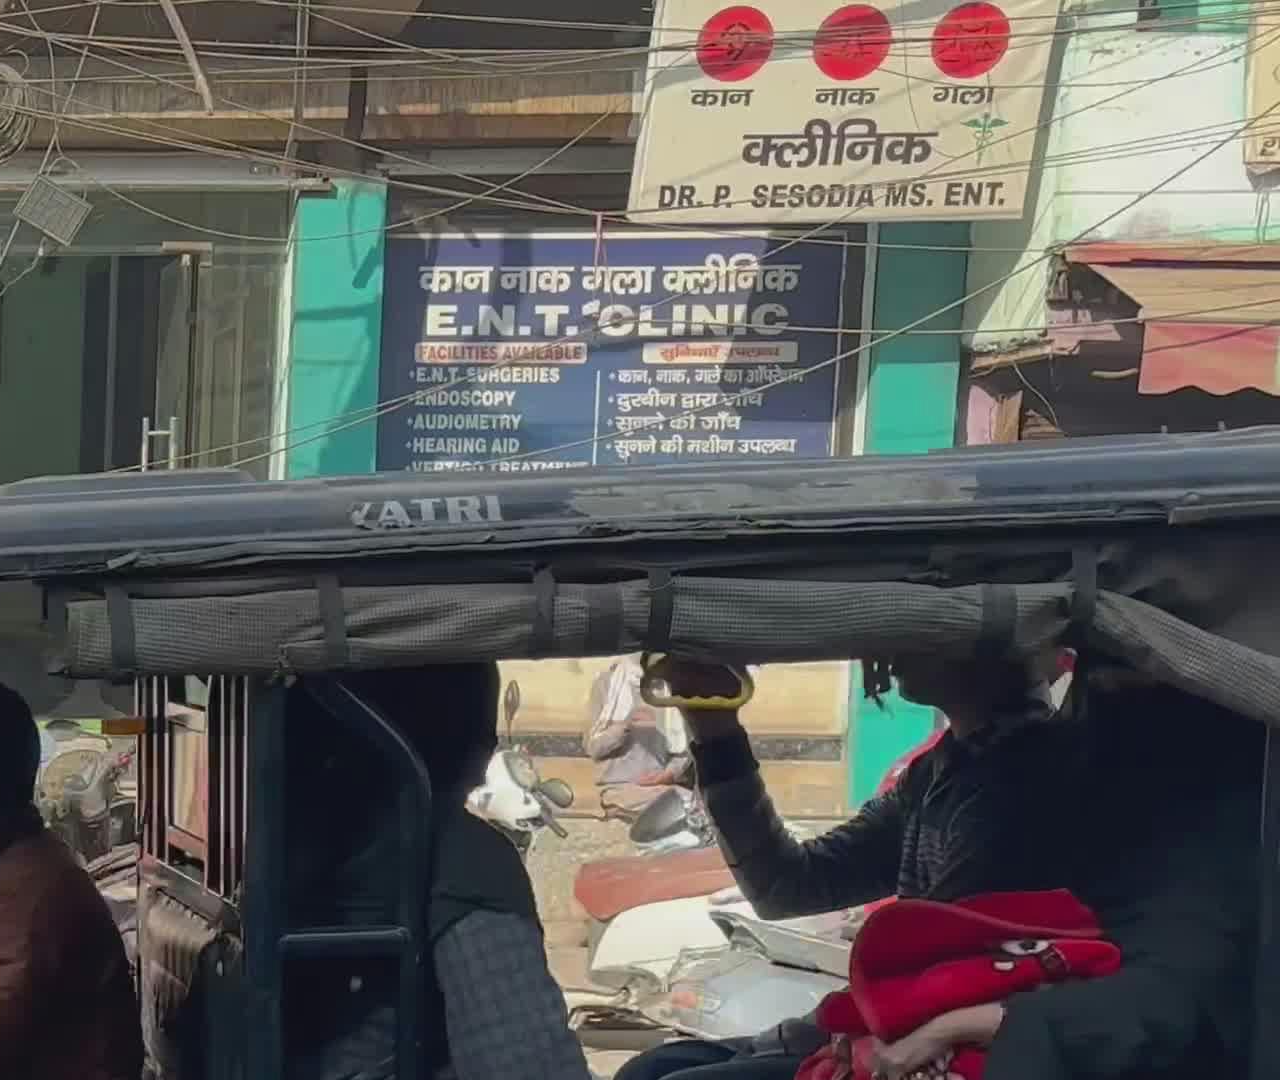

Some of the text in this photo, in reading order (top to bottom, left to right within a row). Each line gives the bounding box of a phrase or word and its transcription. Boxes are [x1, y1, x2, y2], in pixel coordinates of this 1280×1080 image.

[691, 86, 994, 107] कान नाक गला
[742, 118, 939, 168] क्लीनिक
[658, 181, 1006, 209] DR. P. SESODIA MS. ENT.
[419, 253, 802, 295] कान नाक गला क्लीनिक
[425, 303, 790, 336] E.N.T. CLINIC
[418, 345, 582, 361] FACILITIES AVAILABLE
[467, 367, 560, 384] SURGERIES
[415, 390, 516, 407] ENDOSCOPY
[413, 413, 522, 431] AUDIOMETRY
[412, 437, 521, 454] HEARING AID
